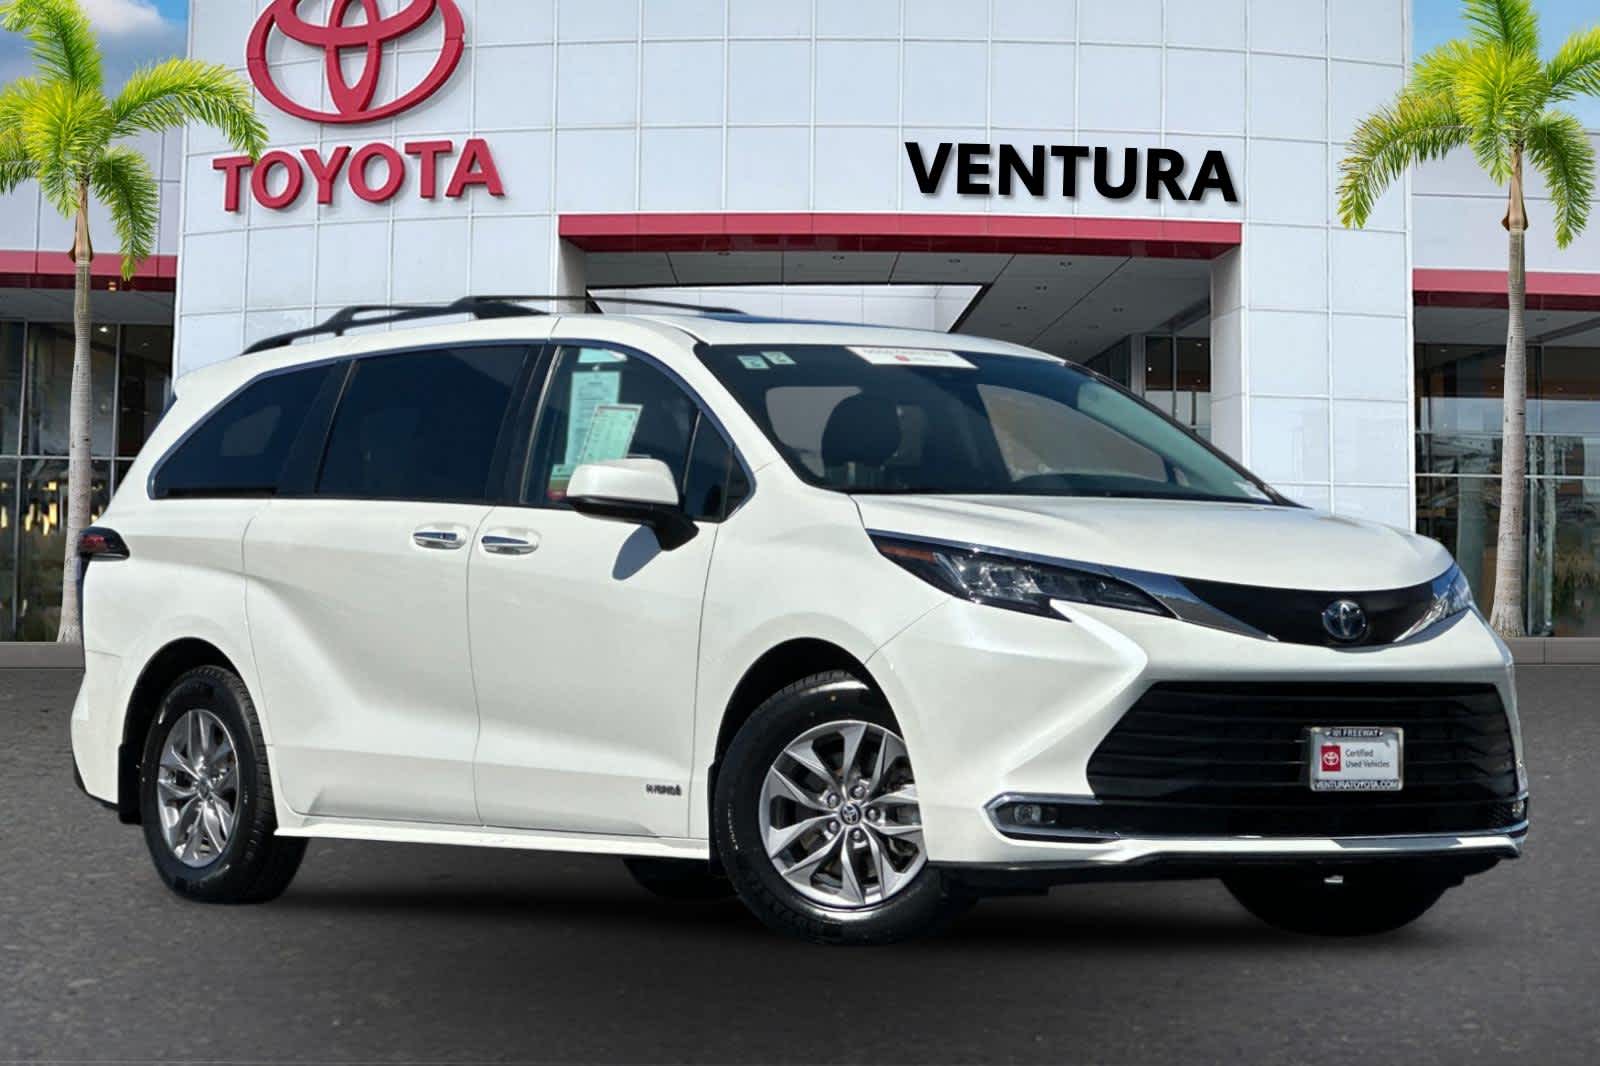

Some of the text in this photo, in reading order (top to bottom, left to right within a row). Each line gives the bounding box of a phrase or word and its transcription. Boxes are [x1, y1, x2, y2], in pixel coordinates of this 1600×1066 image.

[213, 139, 504, 212] TOYOTA
[905, 142, 1238, 201] VENTURA
[1343, 729, 1378, 737] FREEWAY
[1345, 749, 1373, 757] Certified
[1364, 761, 1391, 769] Vehicles
[1315, 781, 1398, 790] VENTURATOYOTA.COM
